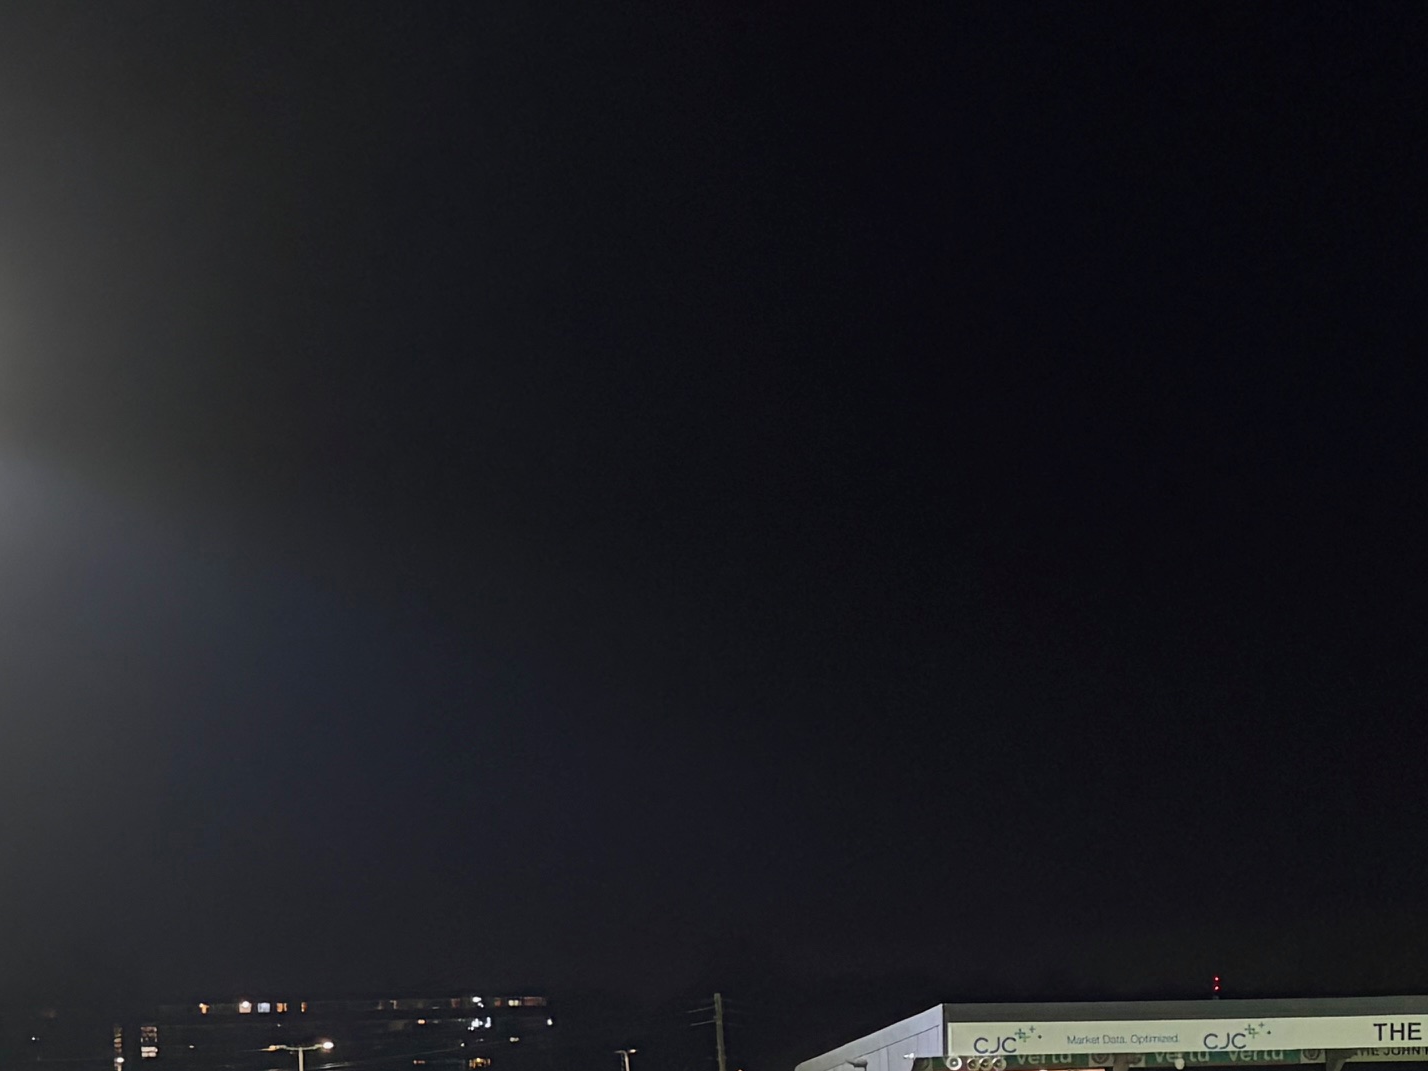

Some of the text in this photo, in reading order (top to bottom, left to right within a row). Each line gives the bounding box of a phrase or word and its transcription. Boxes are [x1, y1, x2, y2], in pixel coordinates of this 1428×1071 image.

[1067, 1033, 1181, 1046] Market Data. Optimized.
[1373, 1023, 1422, 1041] THE
[974, 1037, 1017, 1054] CJC
[1203, 1033, 1247, 1050] CJC
